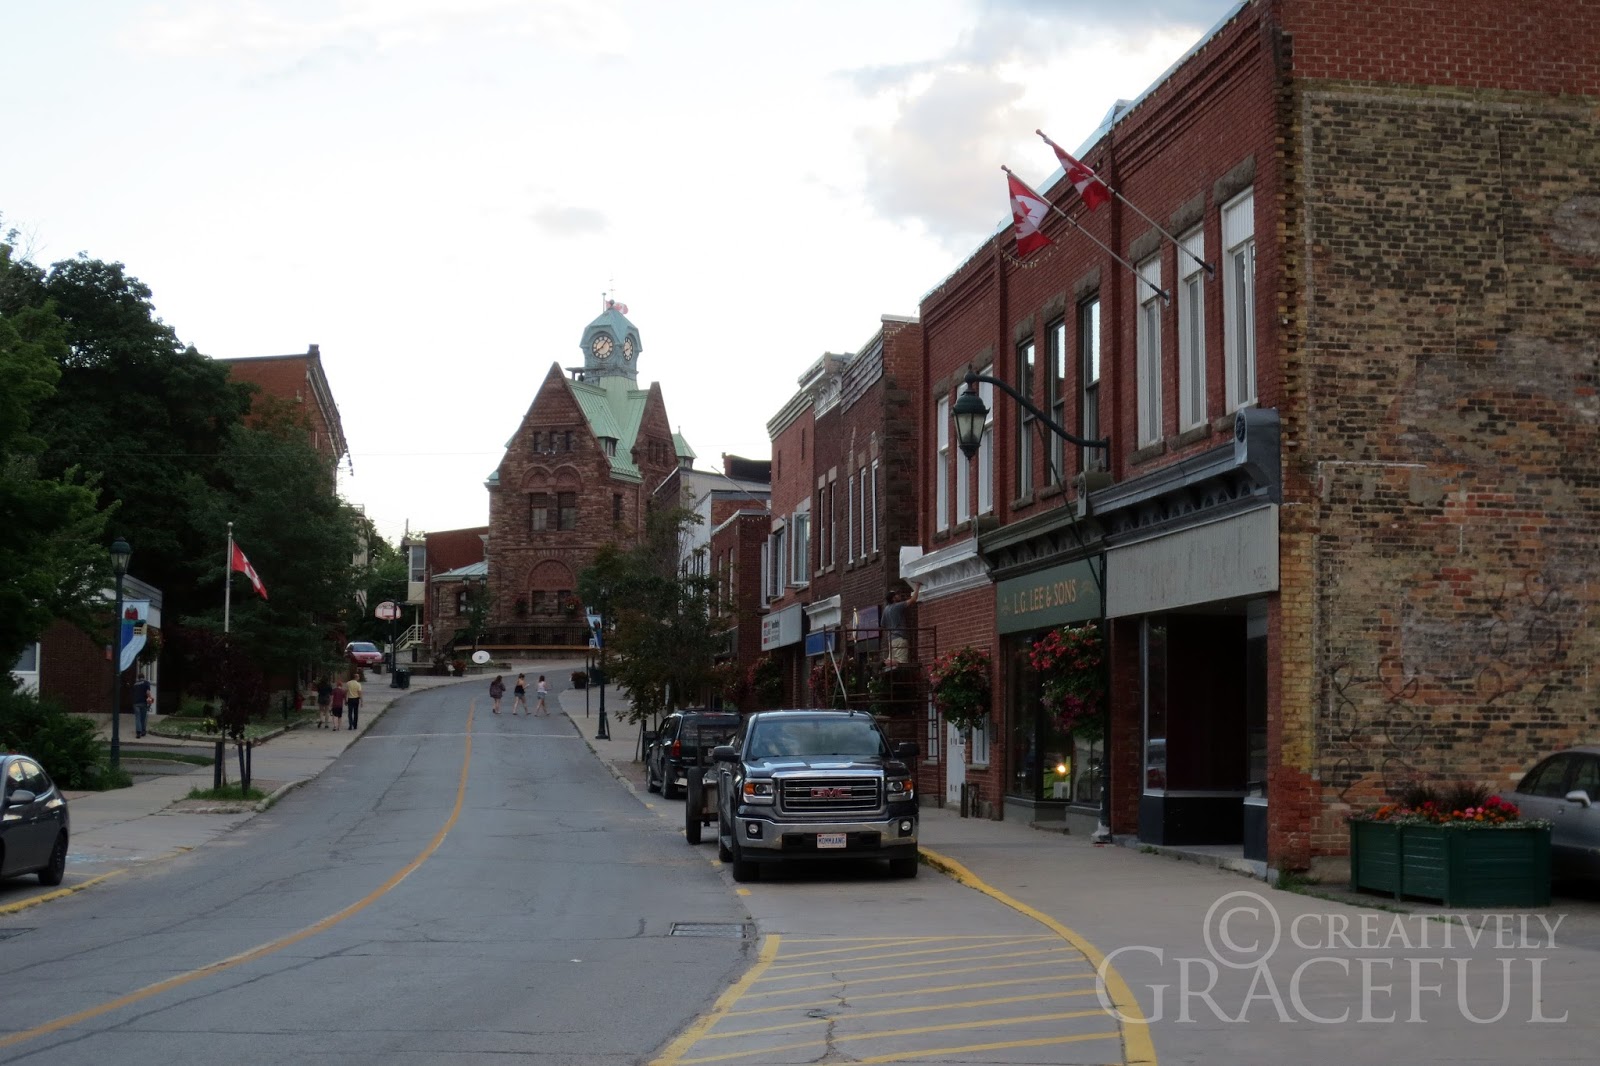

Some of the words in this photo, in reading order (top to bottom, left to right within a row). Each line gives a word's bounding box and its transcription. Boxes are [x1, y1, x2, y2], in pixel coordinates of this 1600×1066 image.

[1030, 586, 1044, 611] LEE
[1046, 585, 1052, 607] &
[1054, 579, 1077, 606] SONS
[810, 787, 852, 799] GMC
